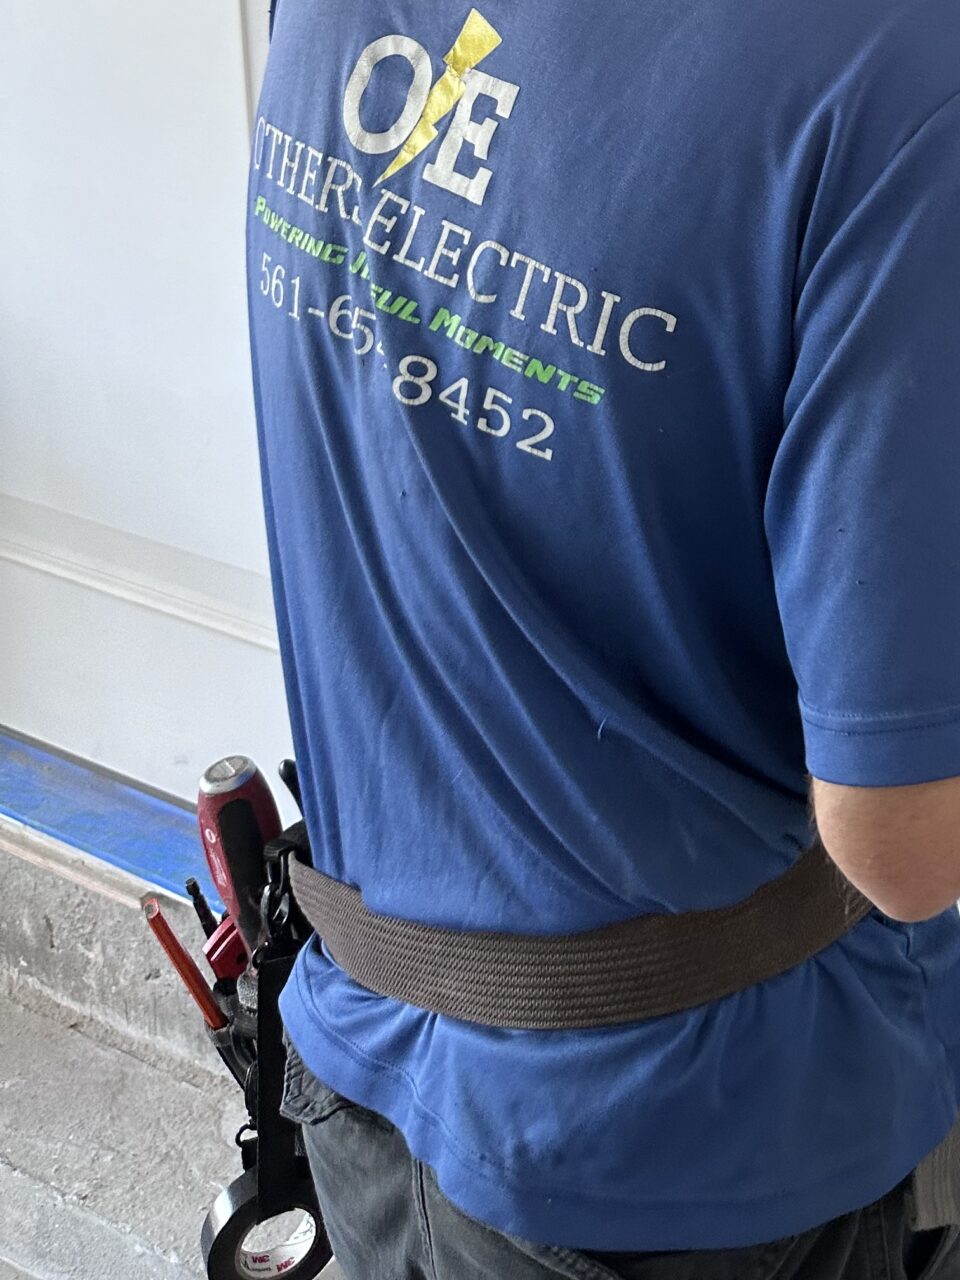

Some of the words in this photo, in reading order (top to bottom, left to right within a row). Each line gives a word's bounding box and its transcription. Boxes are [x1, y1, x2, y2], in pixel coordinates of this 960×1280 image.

[362, 188, 678, 373] ELECTRIC
[427, 313, 607, 406] MOMENTS
[251, 1253, 271, 1264] 3M
[276, 1256, 297, 1273] 3M
